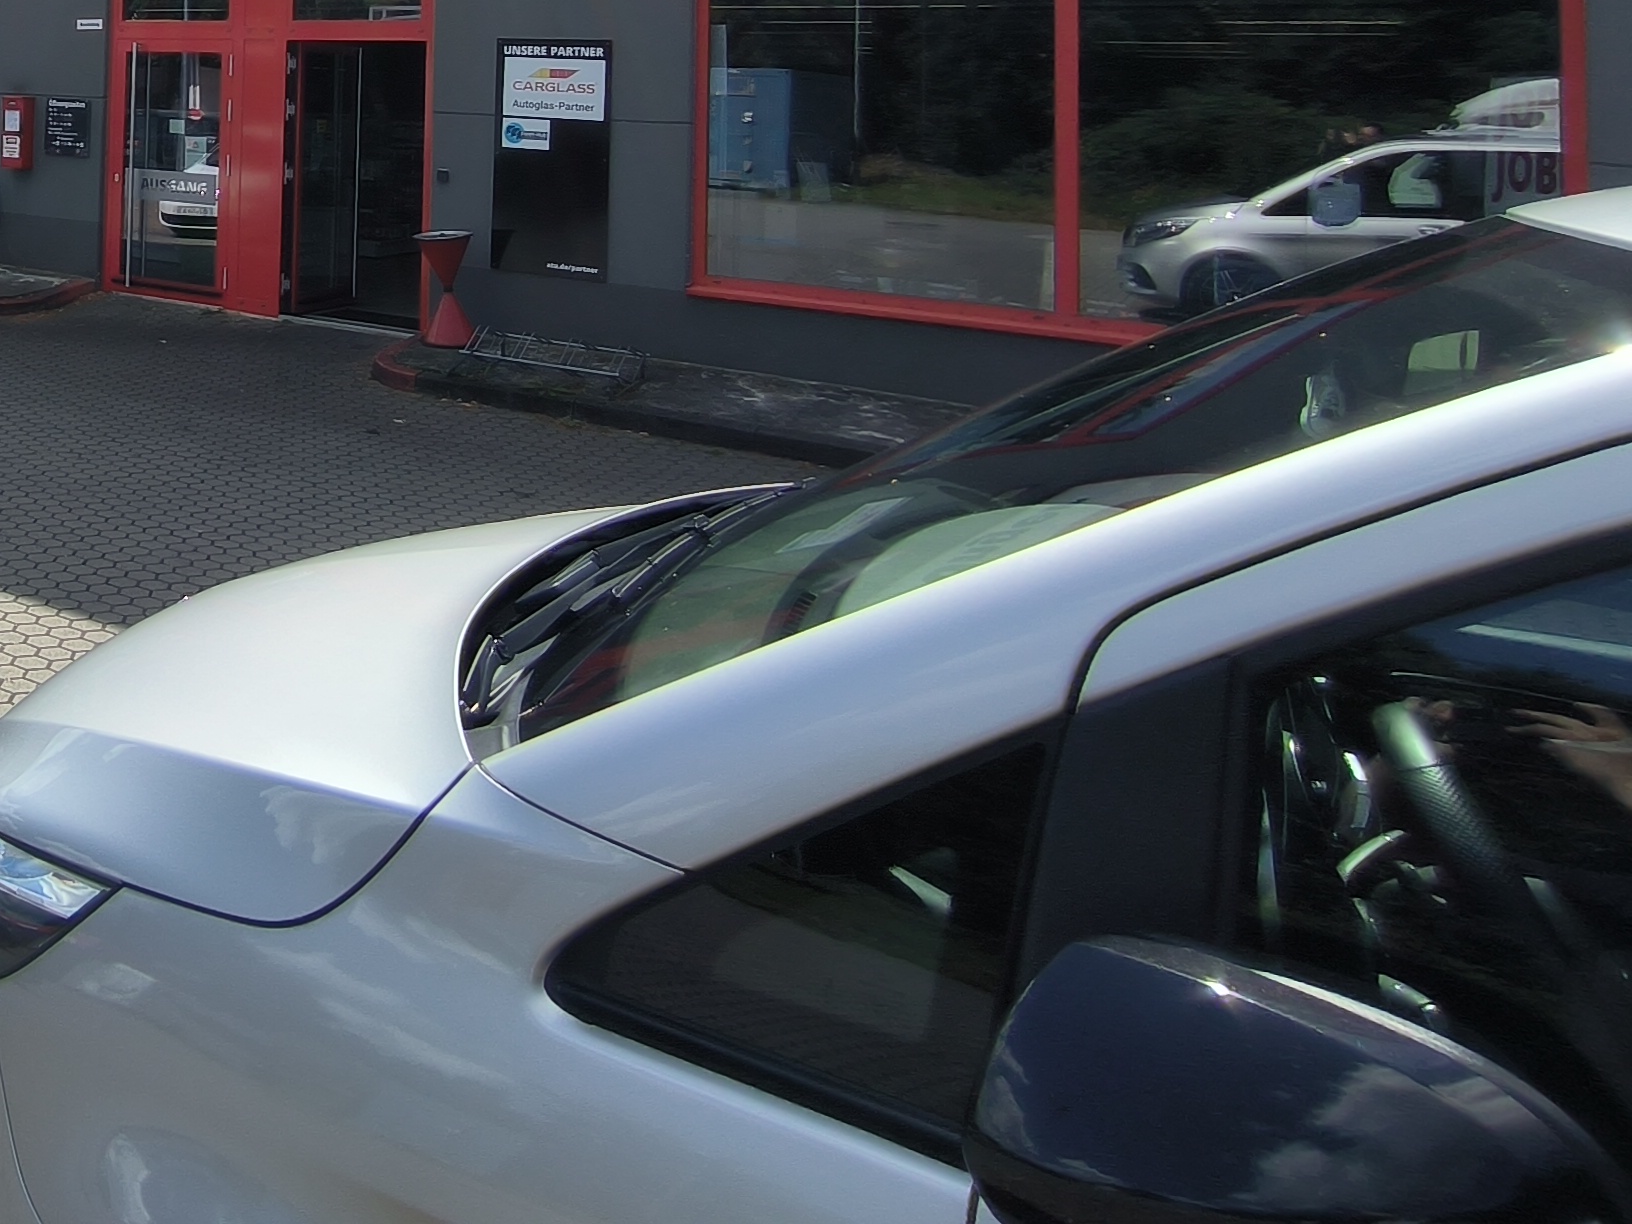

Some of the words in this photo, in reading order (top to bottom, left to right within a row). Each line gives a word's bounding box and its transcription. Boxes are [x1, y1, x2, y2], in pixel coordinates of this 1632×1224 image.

[503, 45, 547, 56] UNSERE
[550, 46, 604, 57] PARTNER
[512, 81, 595, 94] CARGLASS
[512, 99, 595, 112] Autoglas-Partner
[140, 177, 208, 194] AUSGANG
